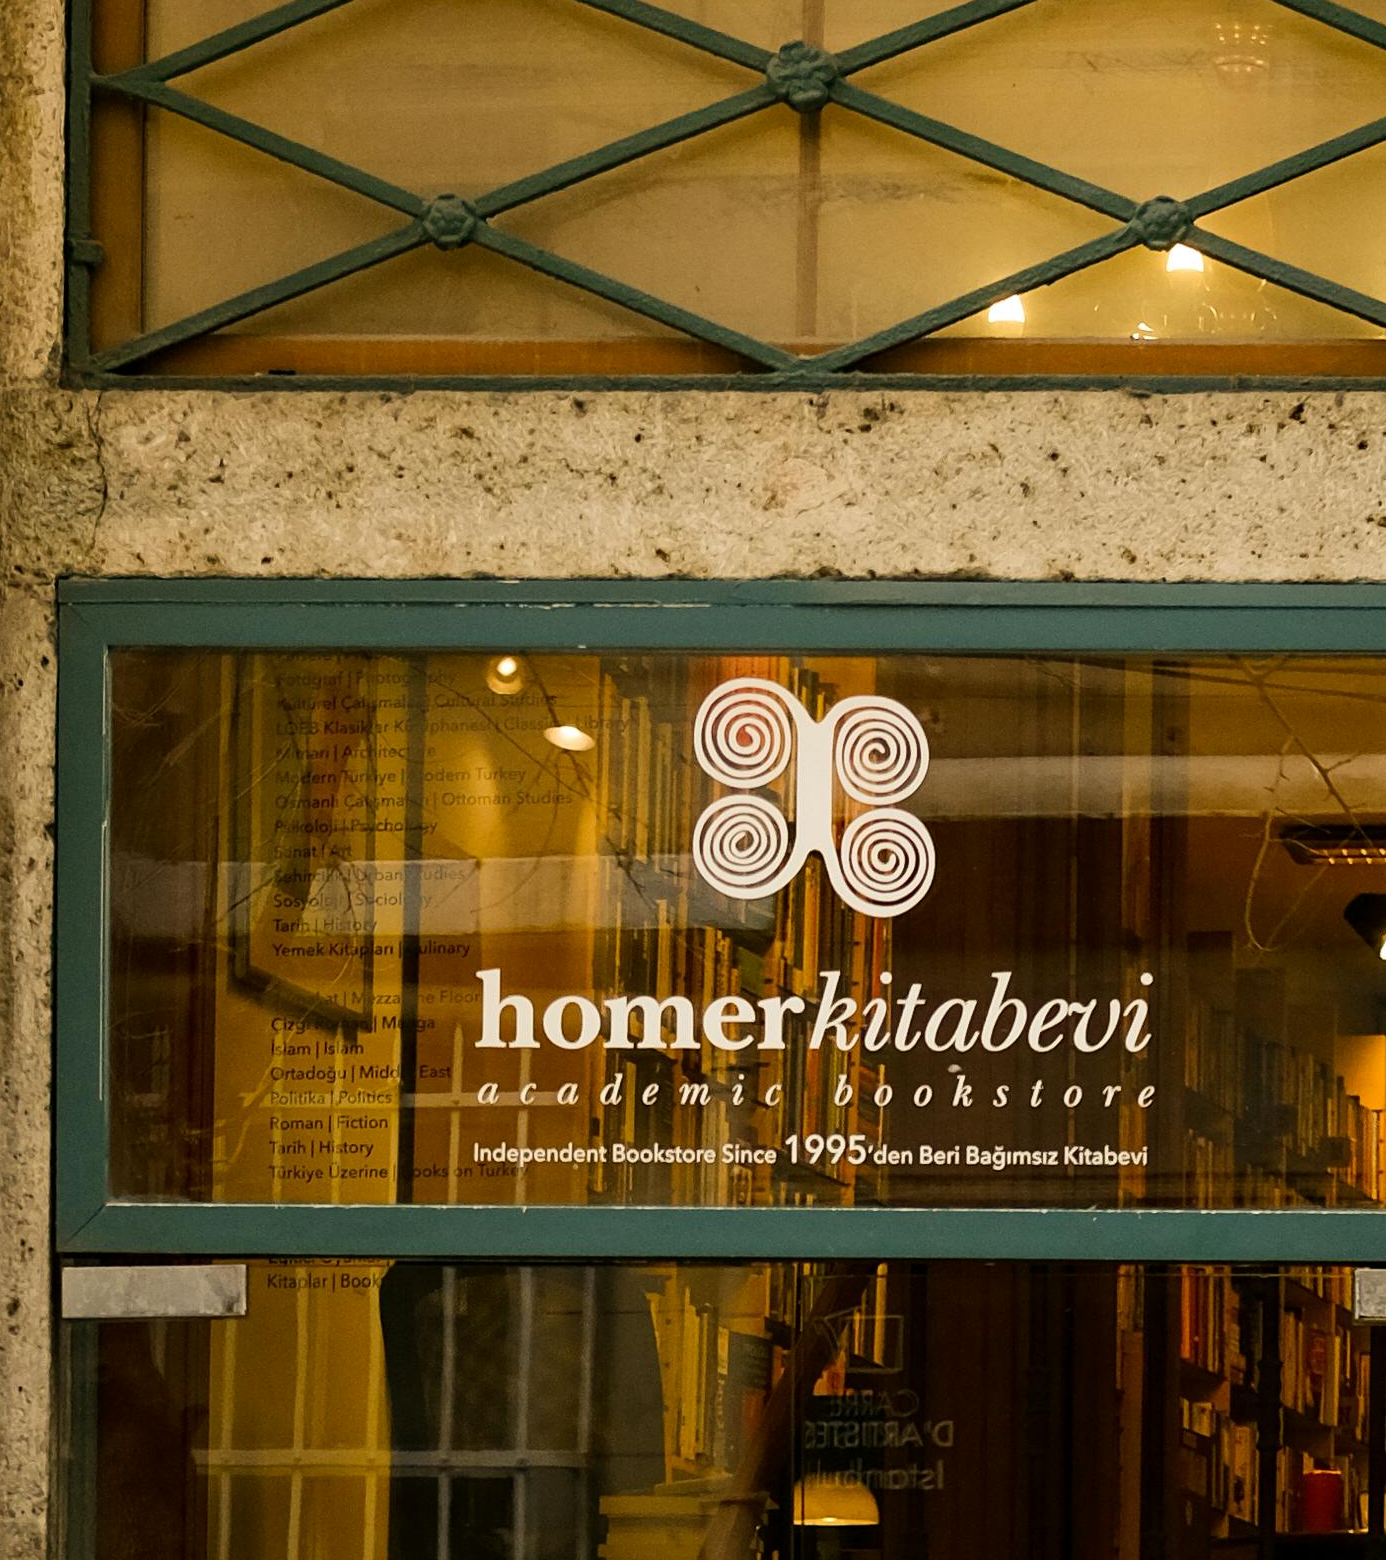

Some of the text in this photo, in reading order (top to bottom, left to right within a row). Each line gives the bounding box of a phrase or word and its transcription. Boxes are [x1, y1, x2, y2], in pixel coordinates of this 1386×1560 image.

[407, 766, 471, 782] odern
[475, 767, 527, 787] Turkey
[441, 792, 512, 808] Ottoman
[516, 791, 574, 807] Studies
[272, 943, 325, 958] Yemek
[406, 941, 471, 960] ulinary
[419, 1065, 452, 1080] East
[269, 1089, 392, 1106] Politika Politics
[476, 1073, 1156, 1109] academic bookstore
[269, 1114, 389, 1131] Roman Fiction
[269, 1140, 374, 1162] Tarih History
[473, 1142, 607, 1171] Independent
[612, 1143, 716, 1165] Bookstore
[721, 1143, 777, 1165] Since
[919, 1144, 963, 1166] Beri
[966, 1144, 1060, 1171] Bağımsız
[1063, 1143, 1149, 1168] Kitabevi
[269, 1165, 325, 1186] Türkiye
[329, 1160, 389, 1181] Üzerine
[266, 1274, 328, 1295] Kitaplar
